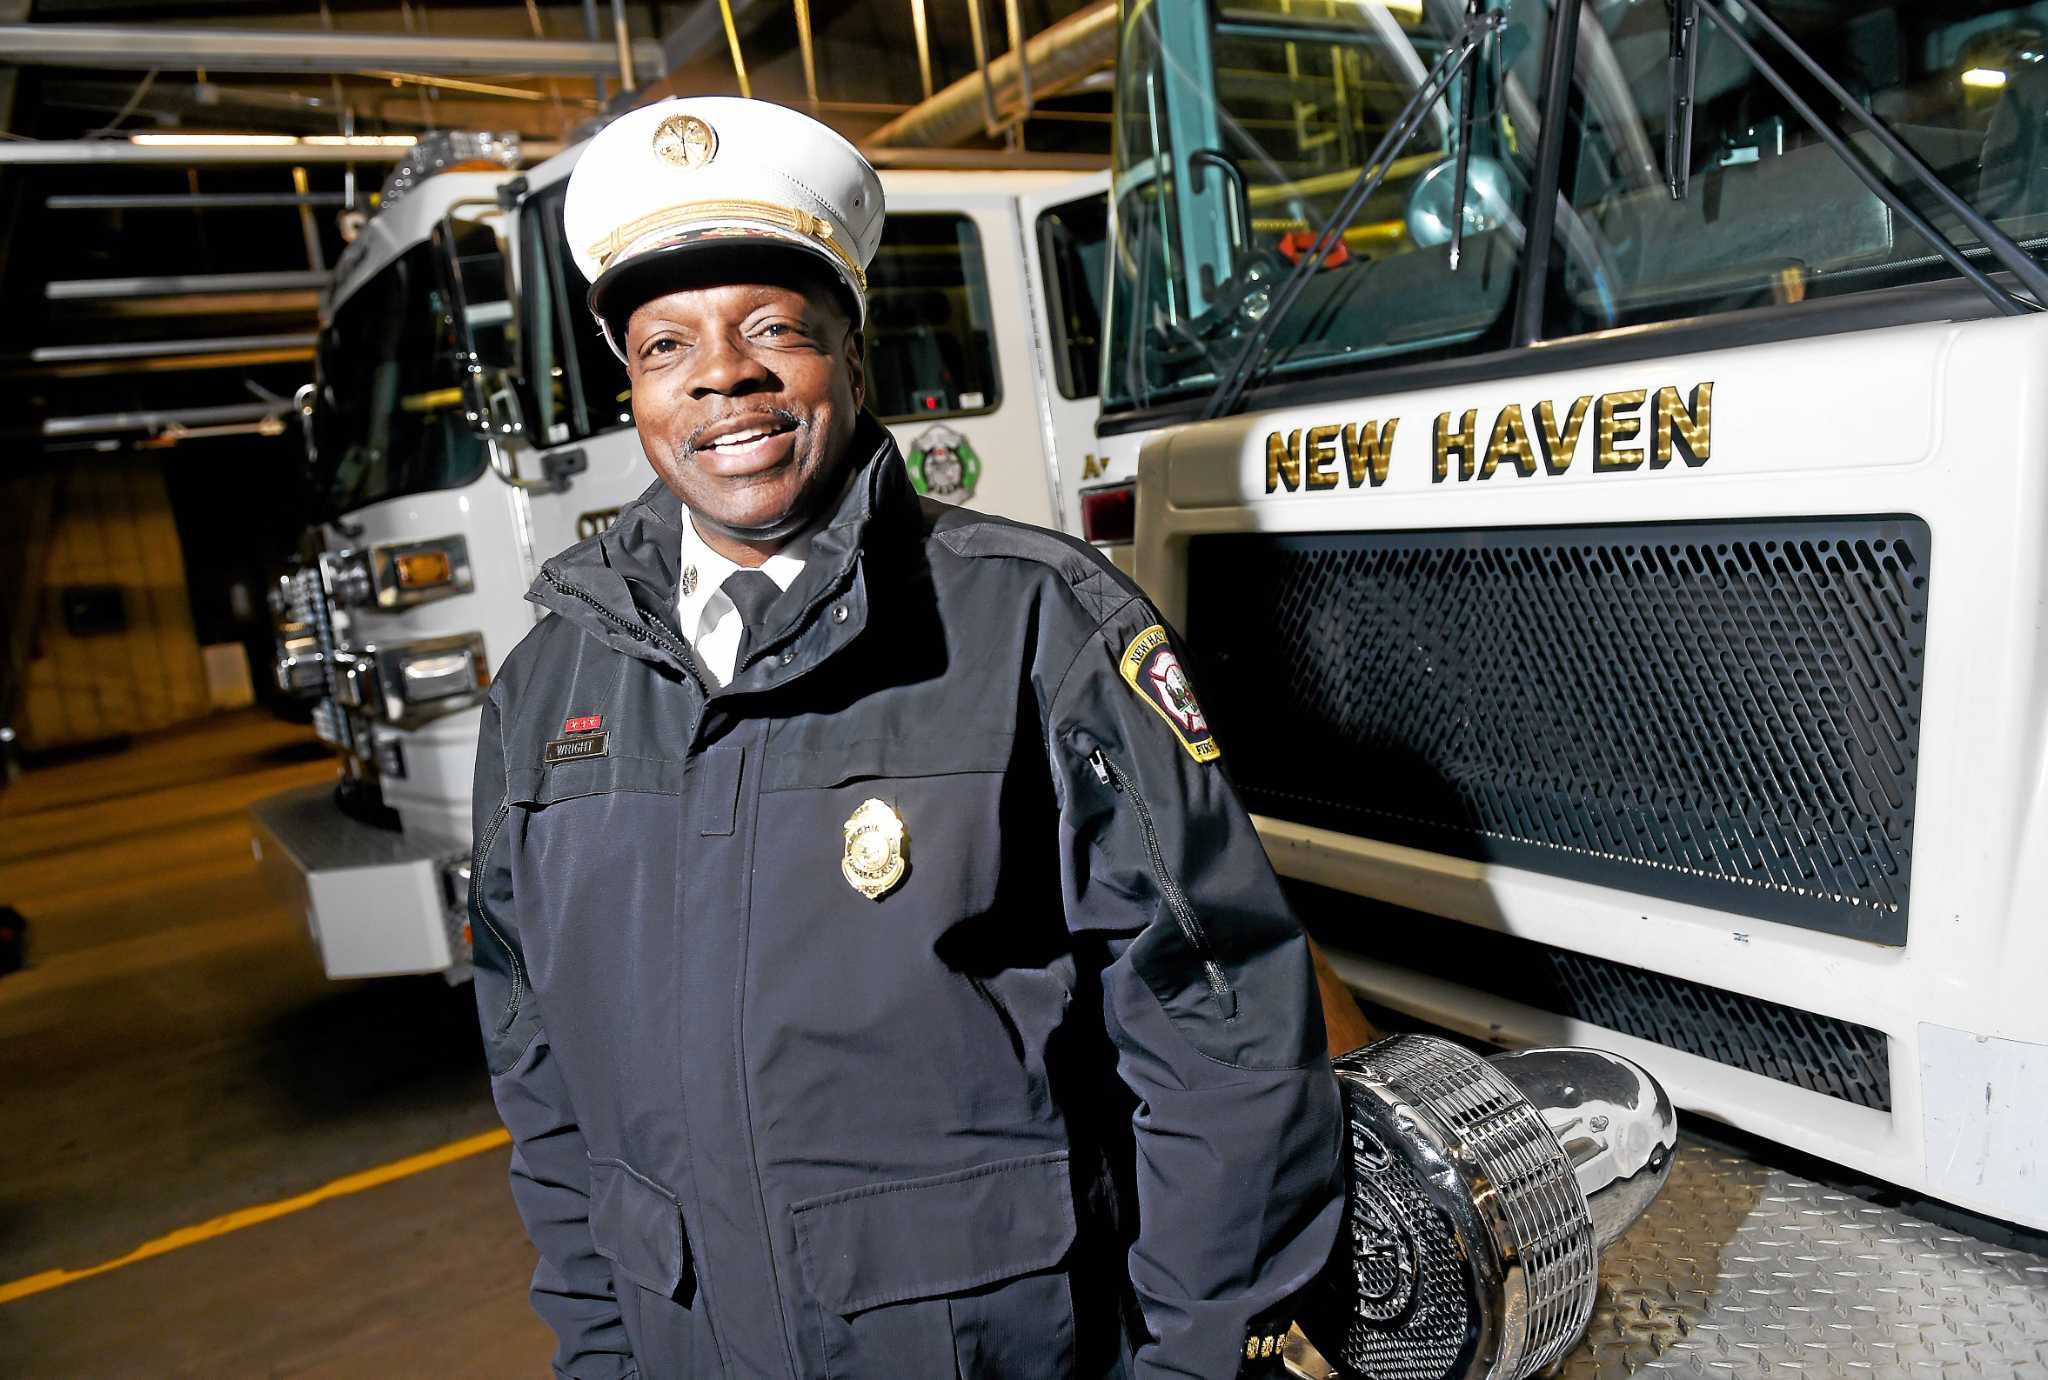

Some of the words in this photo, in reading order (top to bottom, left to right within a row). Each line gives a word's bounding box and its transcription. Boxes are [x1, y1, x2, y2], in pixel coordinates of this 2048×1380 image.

[1265, 417, 1400, 494] NEW
[1431, 381, 1714, 483] HAVEN
[556, 740, 594, 756] WRIGHT
